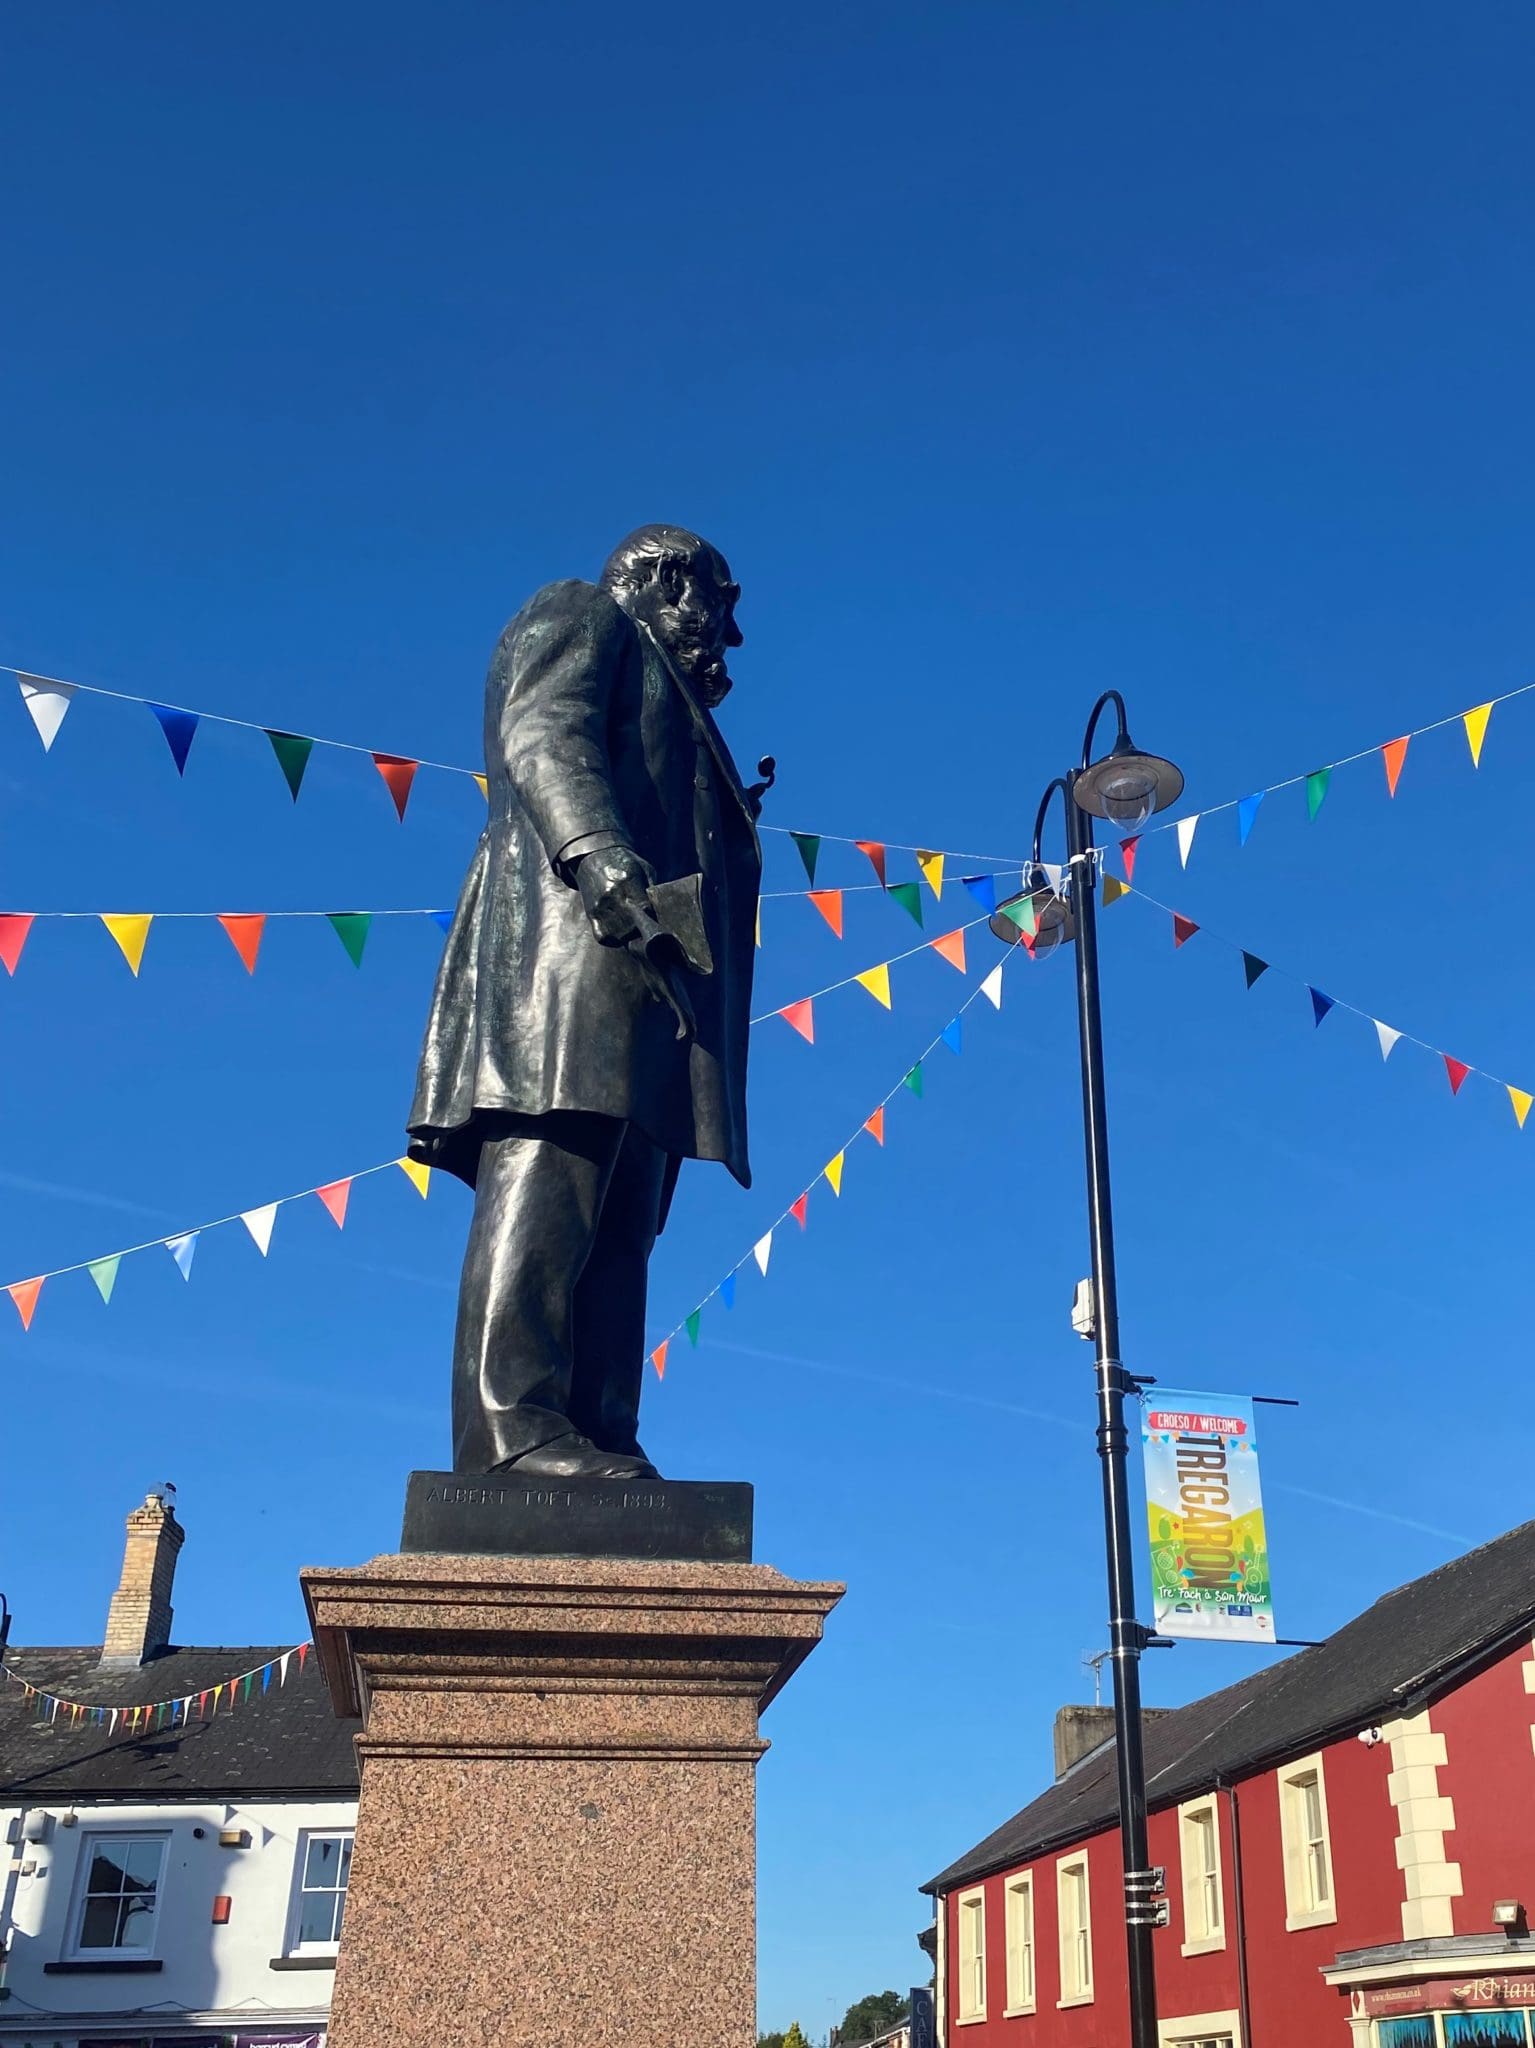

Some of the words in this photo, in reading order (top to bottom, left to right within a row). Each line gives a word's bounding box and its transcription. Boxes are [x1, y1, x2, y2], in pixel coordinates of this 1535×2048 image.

[1157, 1413, 1190, 1430] CROESO
[1200, 1416, 1240, 1434] WELCOME
[427, 1487, 509, 1505] ALBERT
[1176, 1434, 1238, 1590] TREGARON
[1178, 1587, 1202, 1602] Fach
